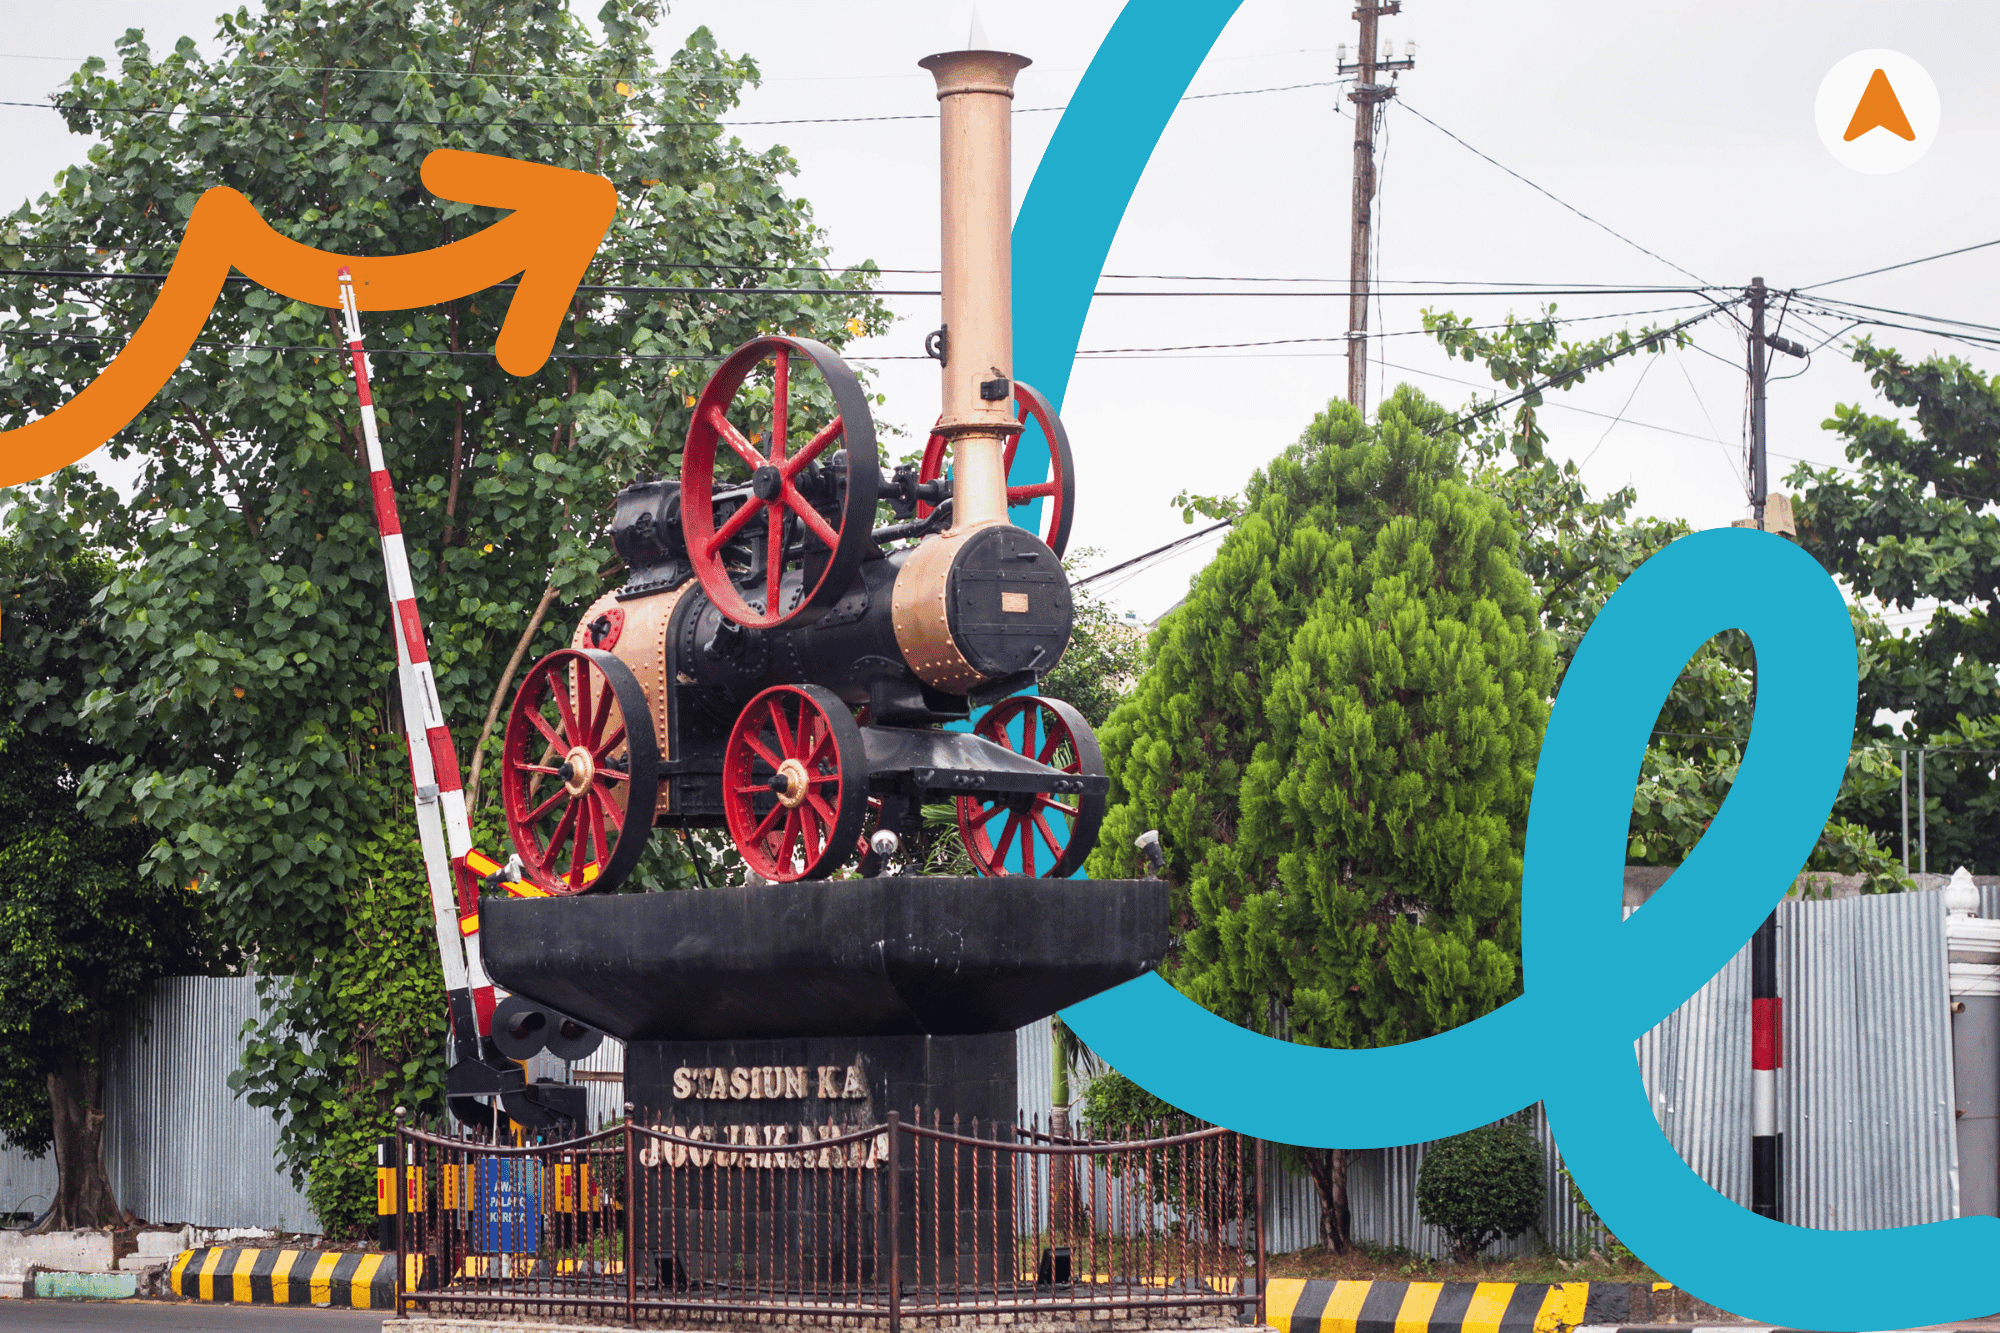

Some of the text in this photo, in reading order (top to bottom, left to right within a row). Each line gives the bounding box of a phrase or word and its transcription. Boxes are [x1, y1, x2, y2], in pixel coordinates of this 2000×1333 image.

[672, 1066, 868, 1099] STASIUN KA
[490, 1212, 526, 1223] KRA
